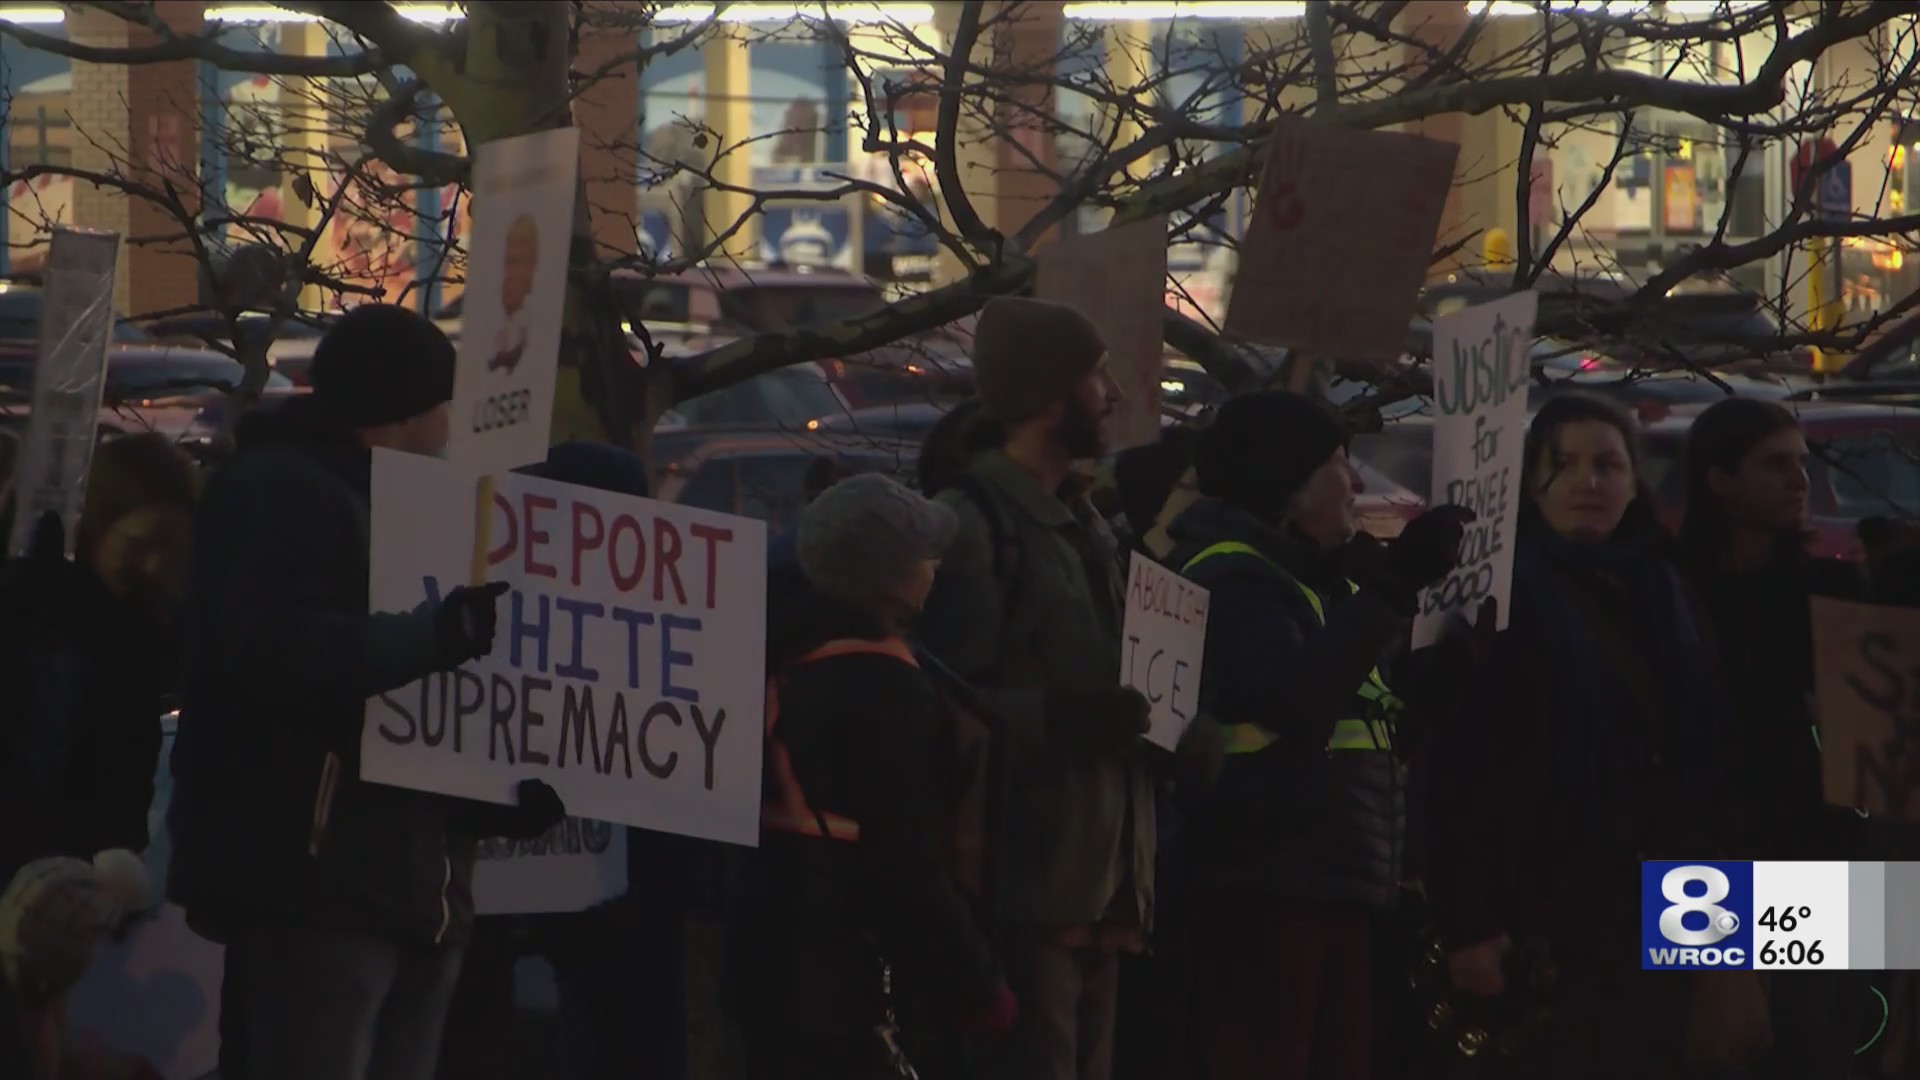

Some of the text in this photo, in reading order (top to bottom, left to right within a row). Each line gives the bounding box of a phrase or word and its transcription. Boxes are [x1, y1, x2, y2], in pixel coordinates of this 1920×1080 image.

[473, 388, 531, 433] LOSER
[487, 490, 733, 609] DEPORT
[423, 576, 702, 702] HITE
[1128, 635, 1189, 720] ICE
[378, 668, 726, 790] SUPREMACY
